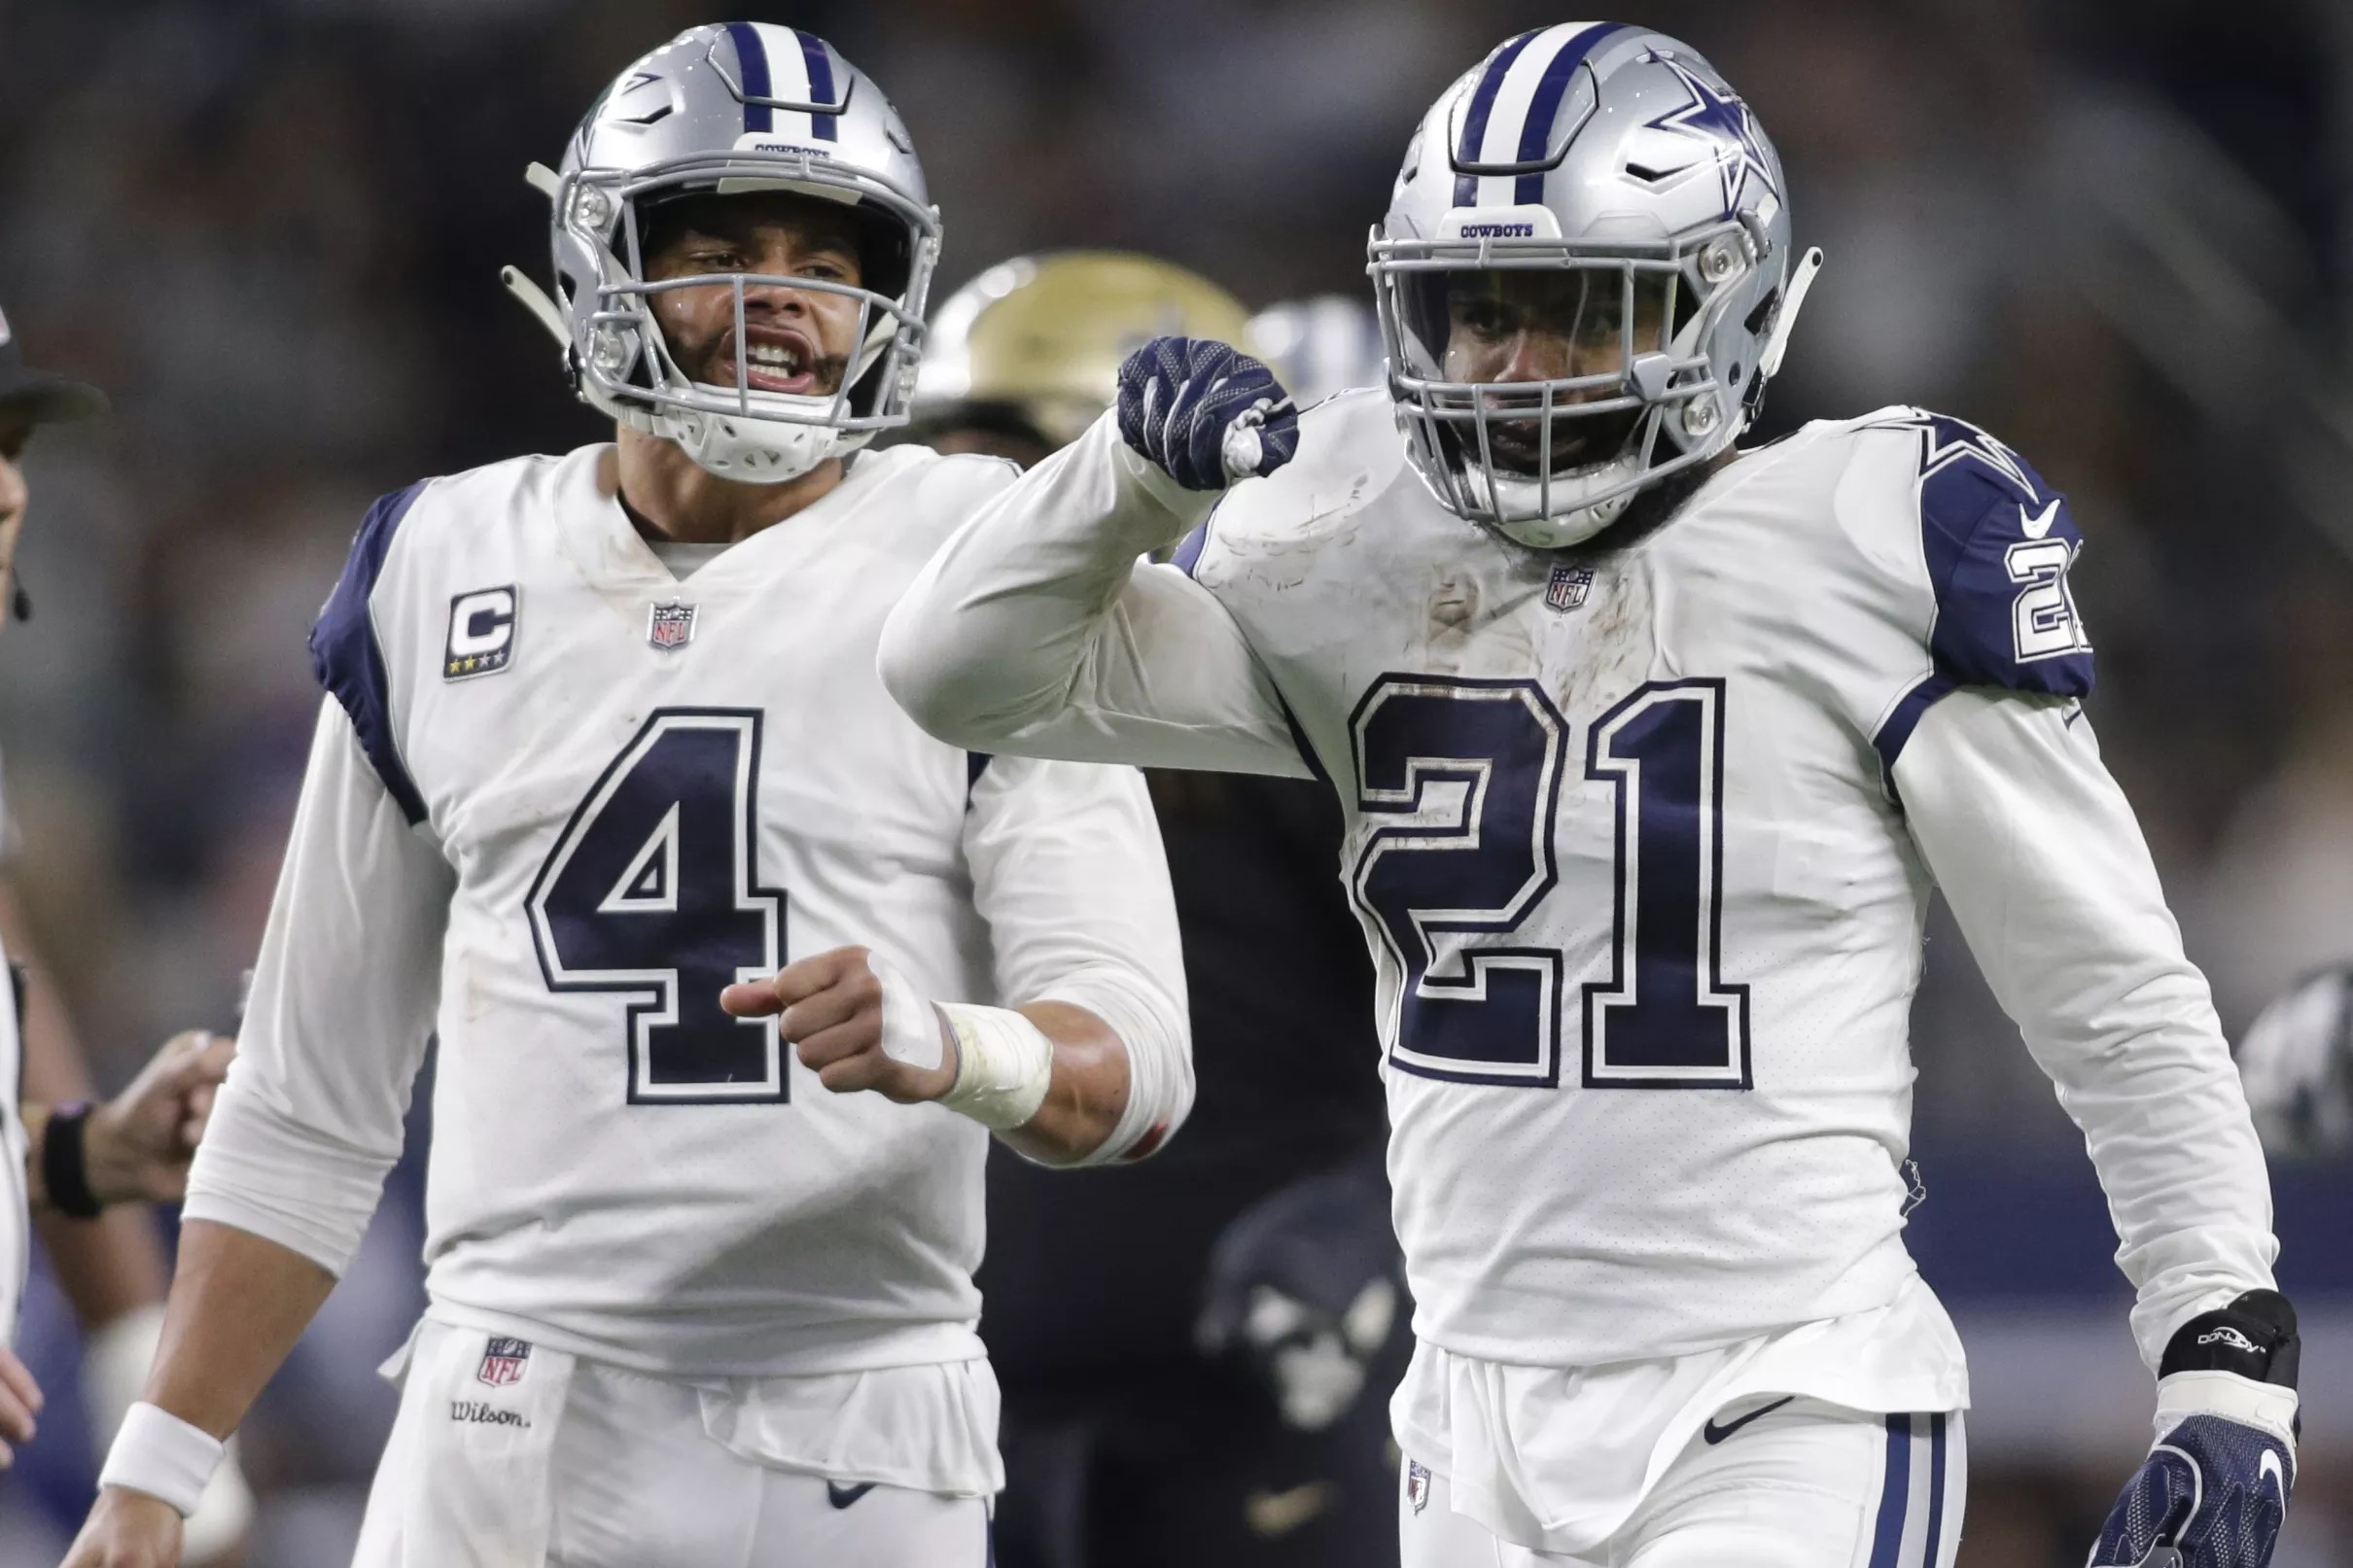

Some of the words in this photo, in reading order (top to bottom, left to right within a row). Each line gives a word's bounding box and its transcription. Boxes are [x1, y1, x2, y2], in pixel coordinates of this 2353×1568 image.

[1460, 224, 1533, 238] COWBOYS
[1550, 584, 1582, 606] NFL
[451, 590, 512, 656] C
[654, 621, 685, 644] NFL
[1348, 672, 1753, 1089] 21
[524, 707, 790, 1105] 4
[481, 1357, 522, 1384] NFL
